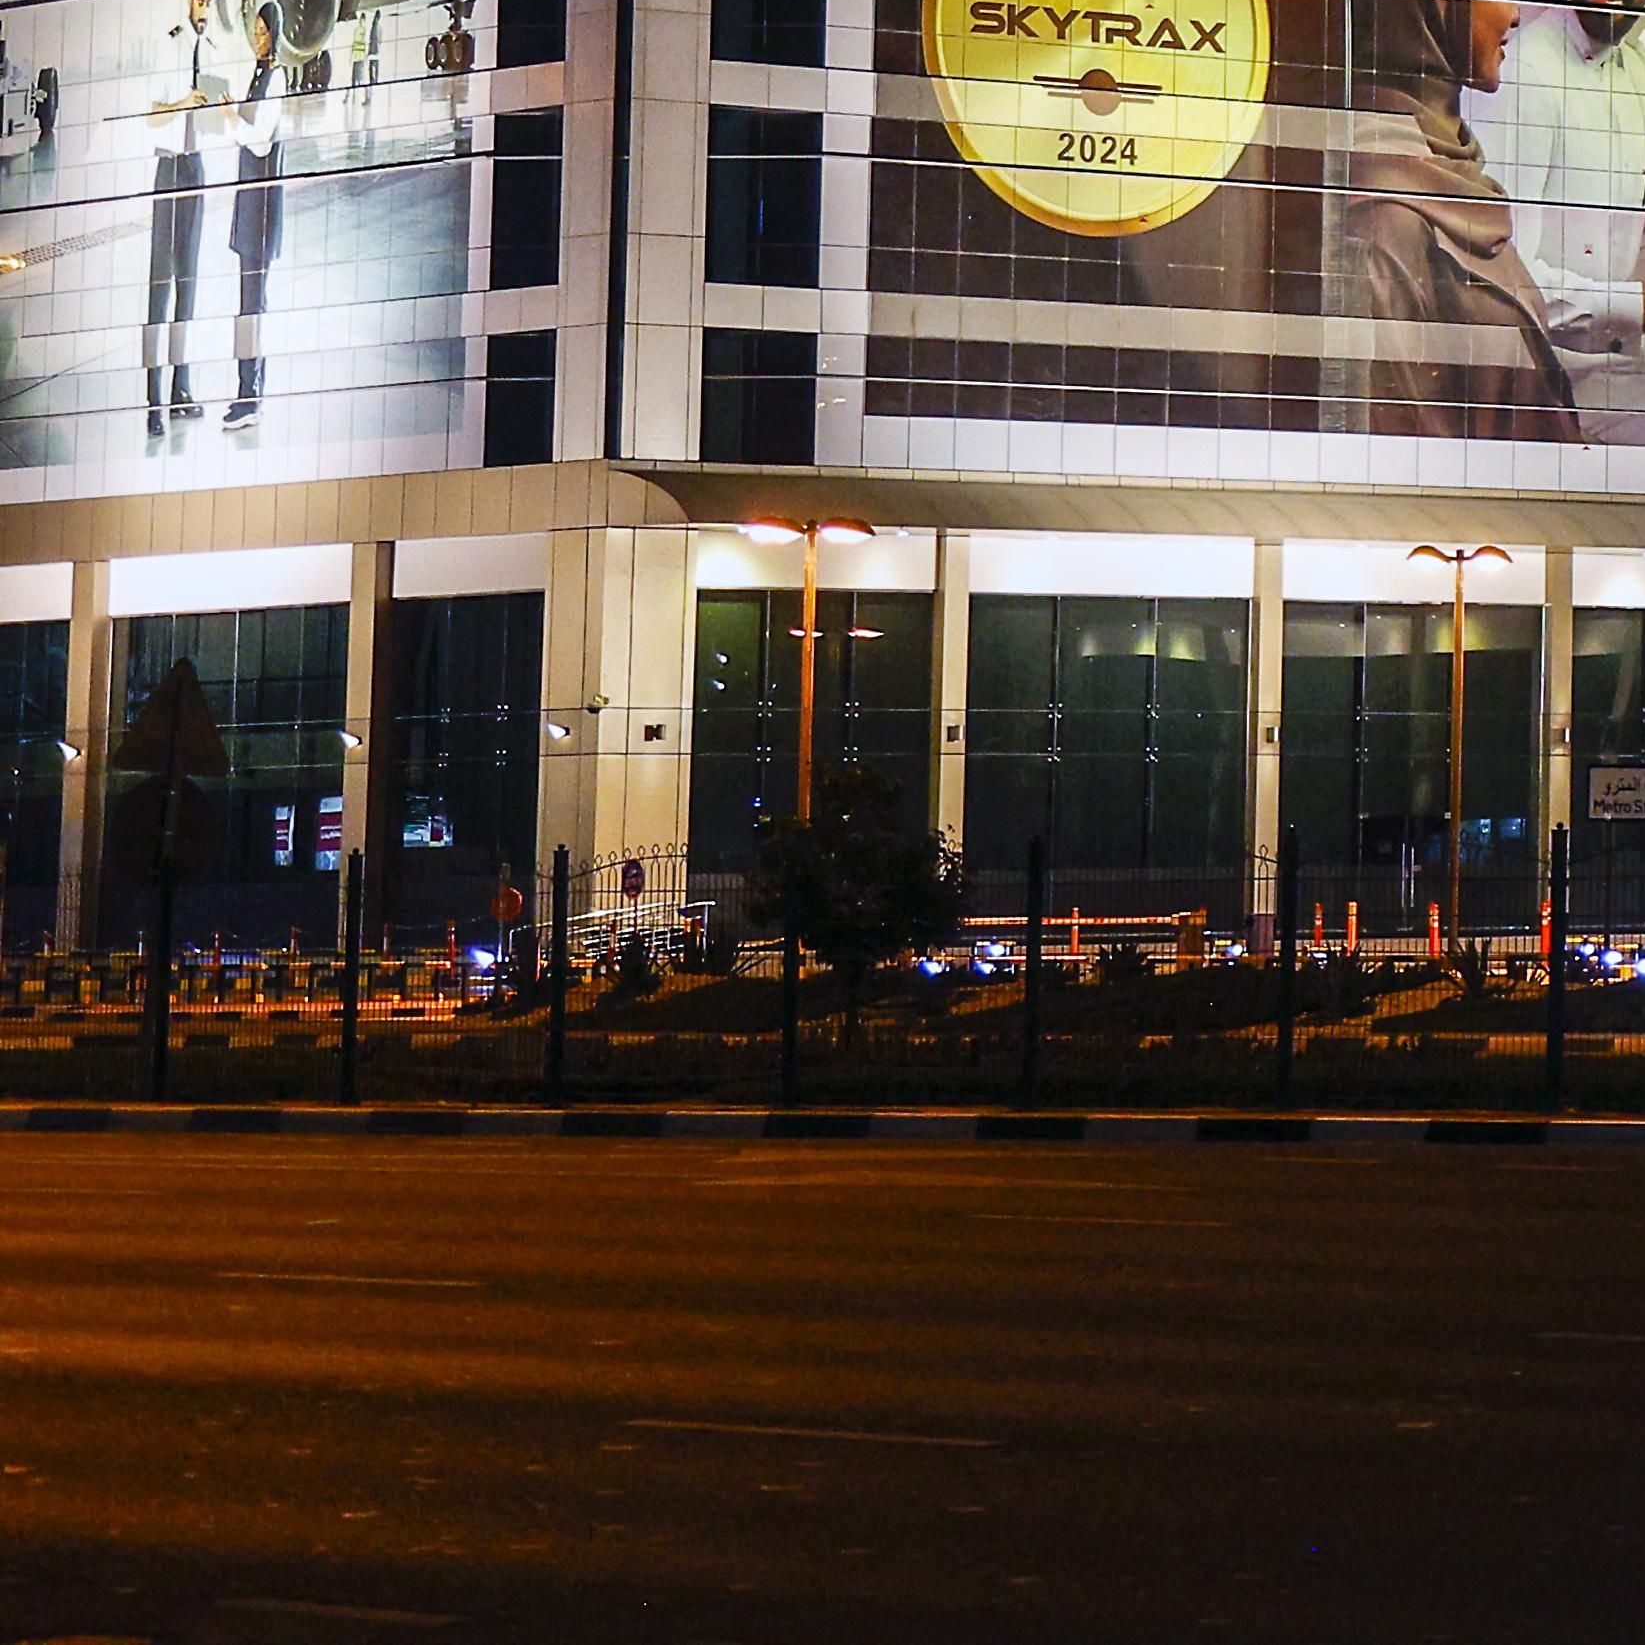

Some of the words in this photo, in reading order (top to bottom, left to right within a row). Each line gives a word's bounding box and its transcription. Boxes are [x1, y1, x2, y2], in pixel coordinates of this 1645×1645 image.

[969, 0, 1227, 53] SKYTRAX
[1057, 132, 1139, 166] 2024
[1593, 800, 1631, 814] Metro
